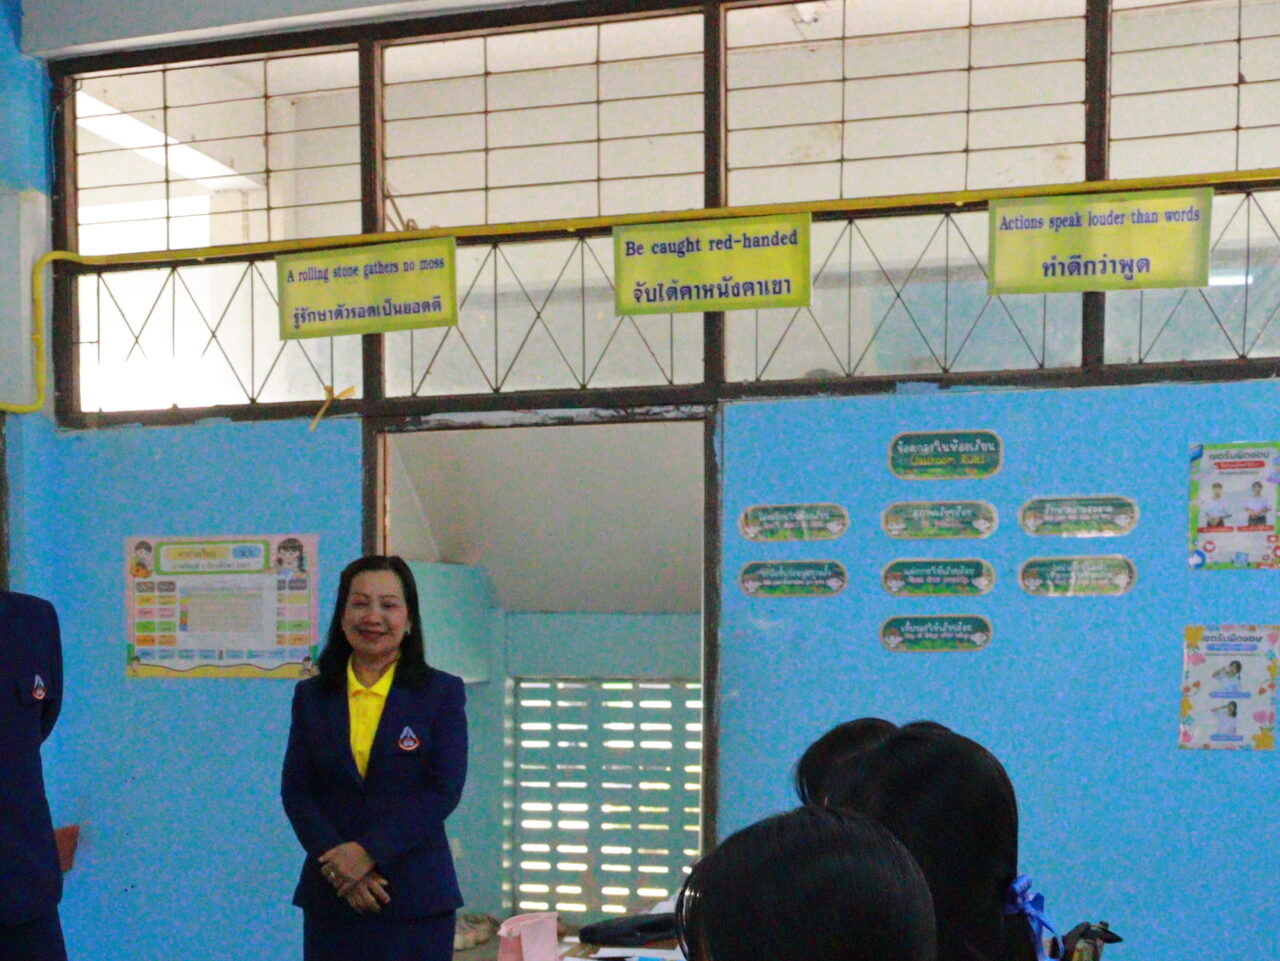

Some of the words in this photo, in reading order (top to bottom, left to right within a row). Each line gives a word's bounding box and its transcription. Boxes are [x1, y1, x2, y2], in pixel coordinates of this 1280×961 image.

[999, 214, 1044, 231] Actions
[1049, 211, 1082, 232] speak
[1088, 210, 1126, 226] louder
[1131, 208, 1158, 224] than
[1165, 206, 1200, 222] words
[625, 241, 644, 256] Be
[652, 237, 701, 257] caught
[709, 229, 798, 251] red-handed
[287, 270, 295, 283] A
[298, 265, 329, 282] rolling
[333, 264, 359, 278] stone
[363, 260, 399, 279] gathers
[403, 261, 415, 271] no
[419, 257, 444, 269] moss
[1042, 253, 1151, 280] ทำดีกว่าพูด
[633, 276, 792, 303] จับได้คาหนังคาเขา
[293, 295, 442, 329] รู้รักษาตัวรอดเป็นยอดดี
